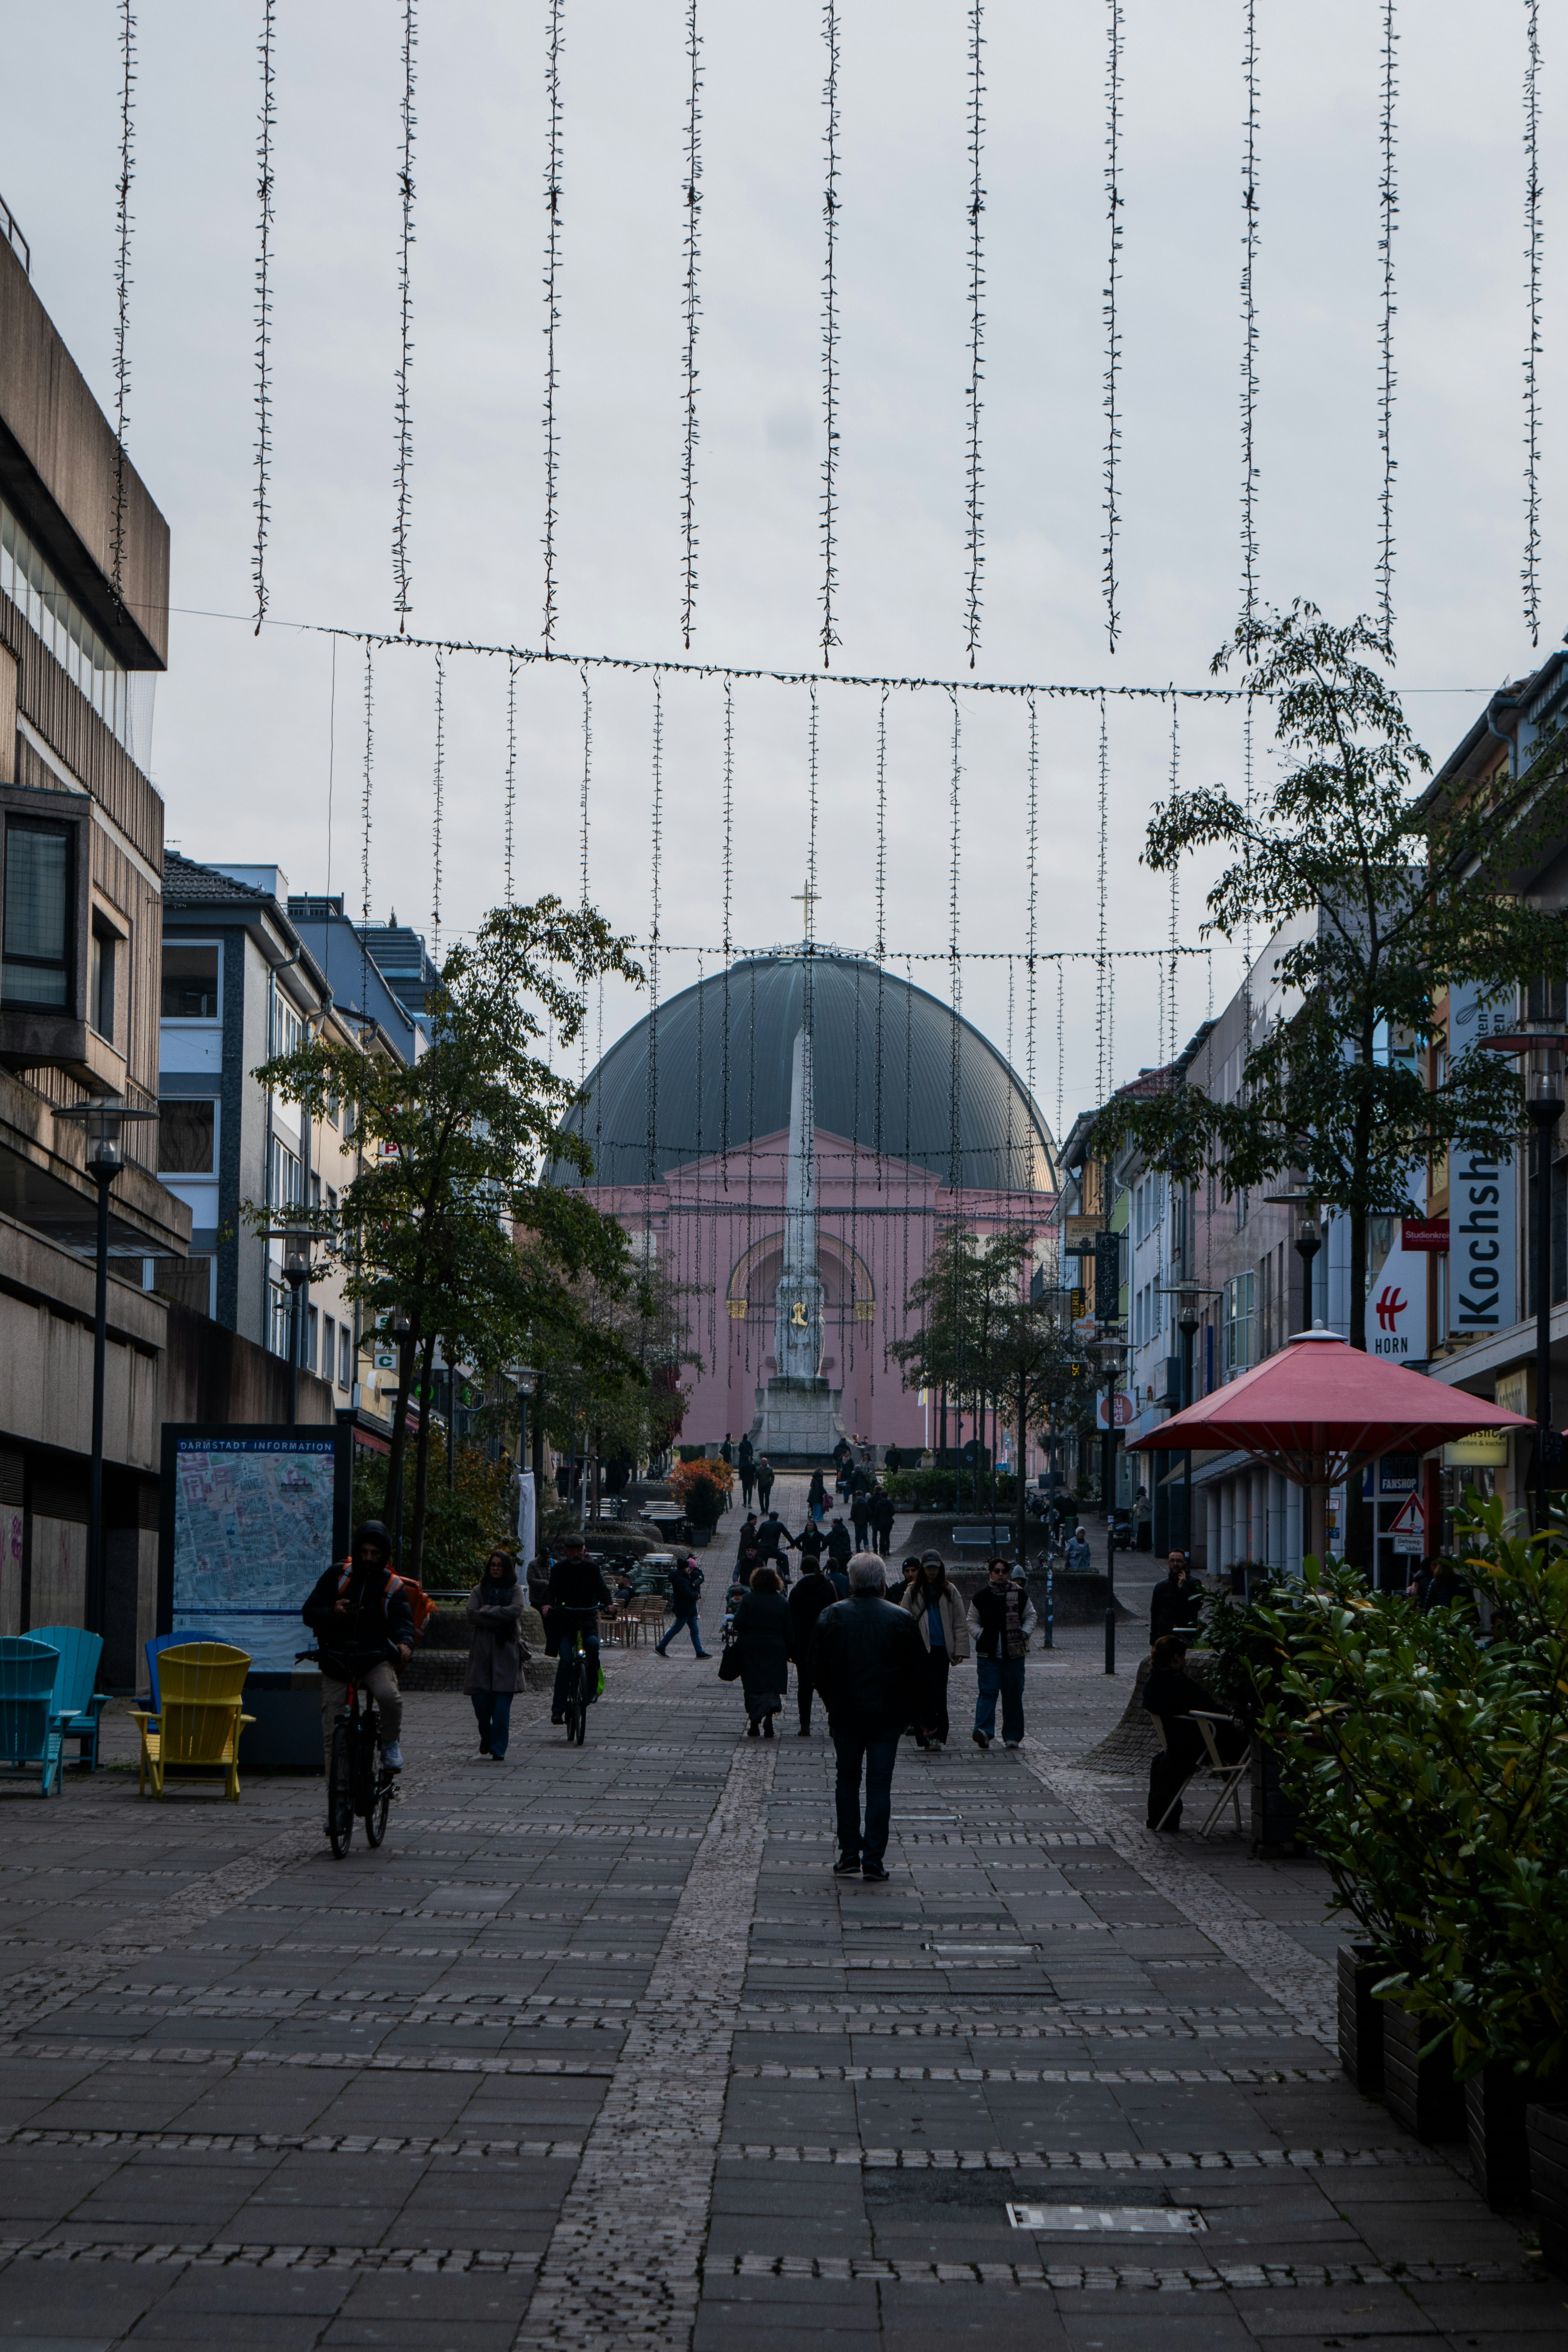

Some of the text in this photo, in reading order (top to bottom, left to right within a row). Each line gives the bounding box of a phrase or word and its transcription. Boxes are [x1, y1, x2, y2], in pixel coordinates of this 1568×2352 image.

[1375, 1337, 1407, 1354] HORN
[180, 1441, 332, 1451] DARMSTADT INFORMATION
[1382, 1457, 1417, 1477] CITY
[1382, 1478, 1417, 1489] FANSHOP
